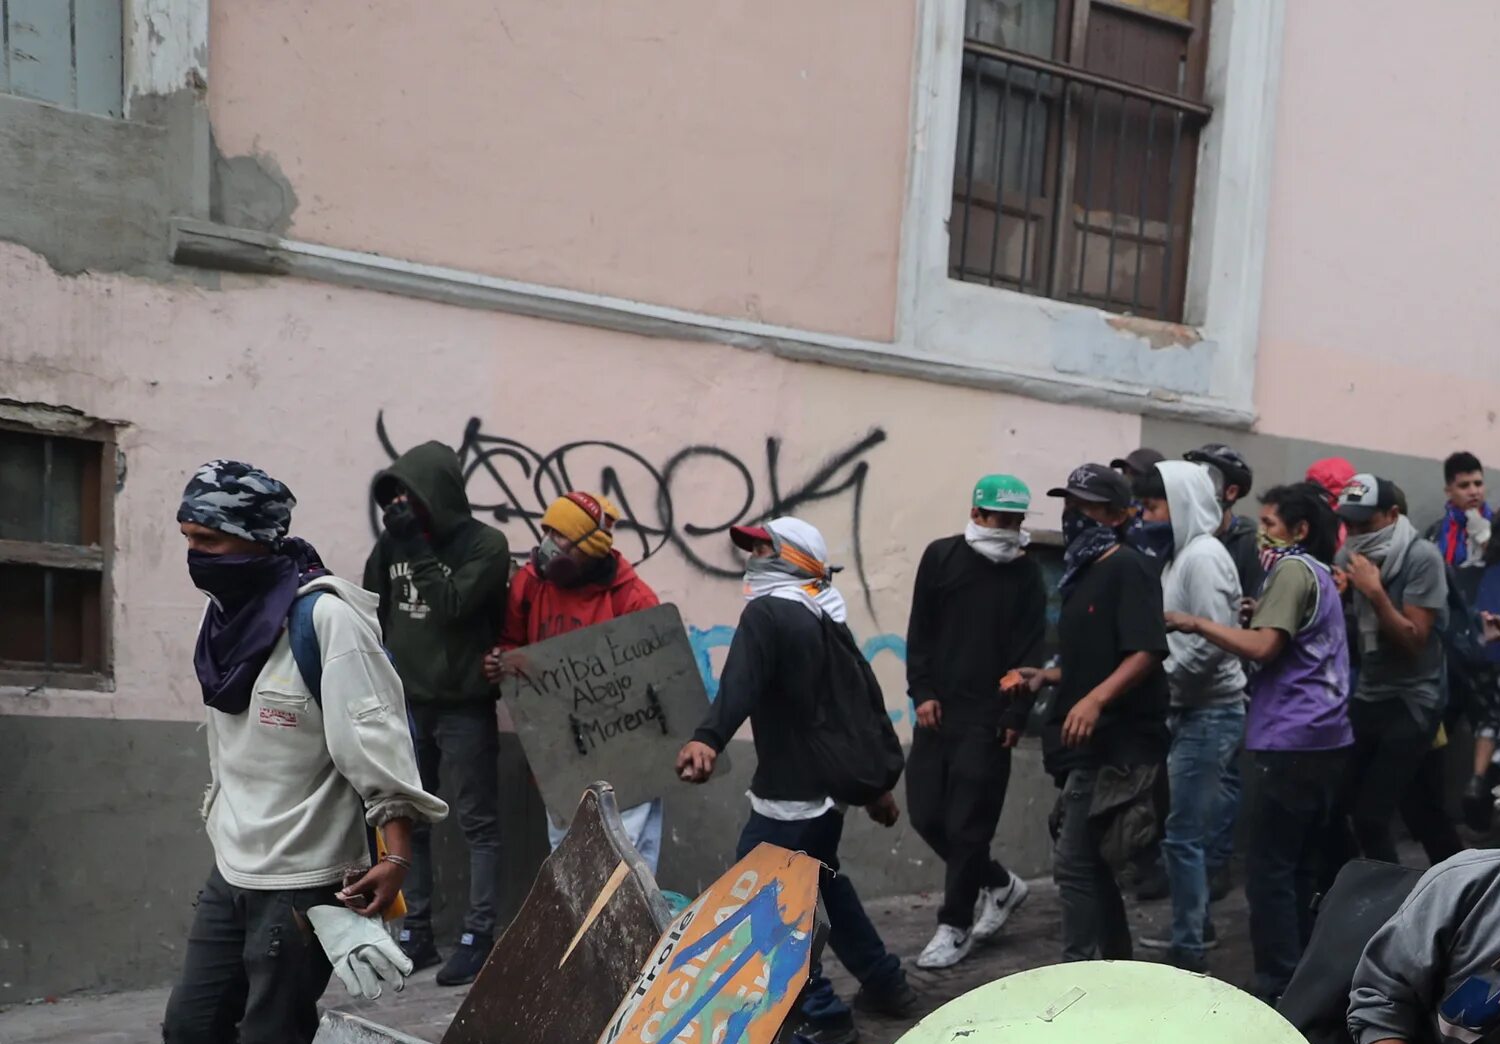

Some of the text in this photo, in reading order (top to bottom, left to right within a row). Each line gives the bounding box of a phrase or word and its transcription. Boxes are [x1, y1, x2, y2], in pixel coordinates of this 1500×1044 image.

[515, 655, 607, 697] Arriba
[573, 674, 632, 712] Abajo
[631, 909, 693, 1000] Trole
